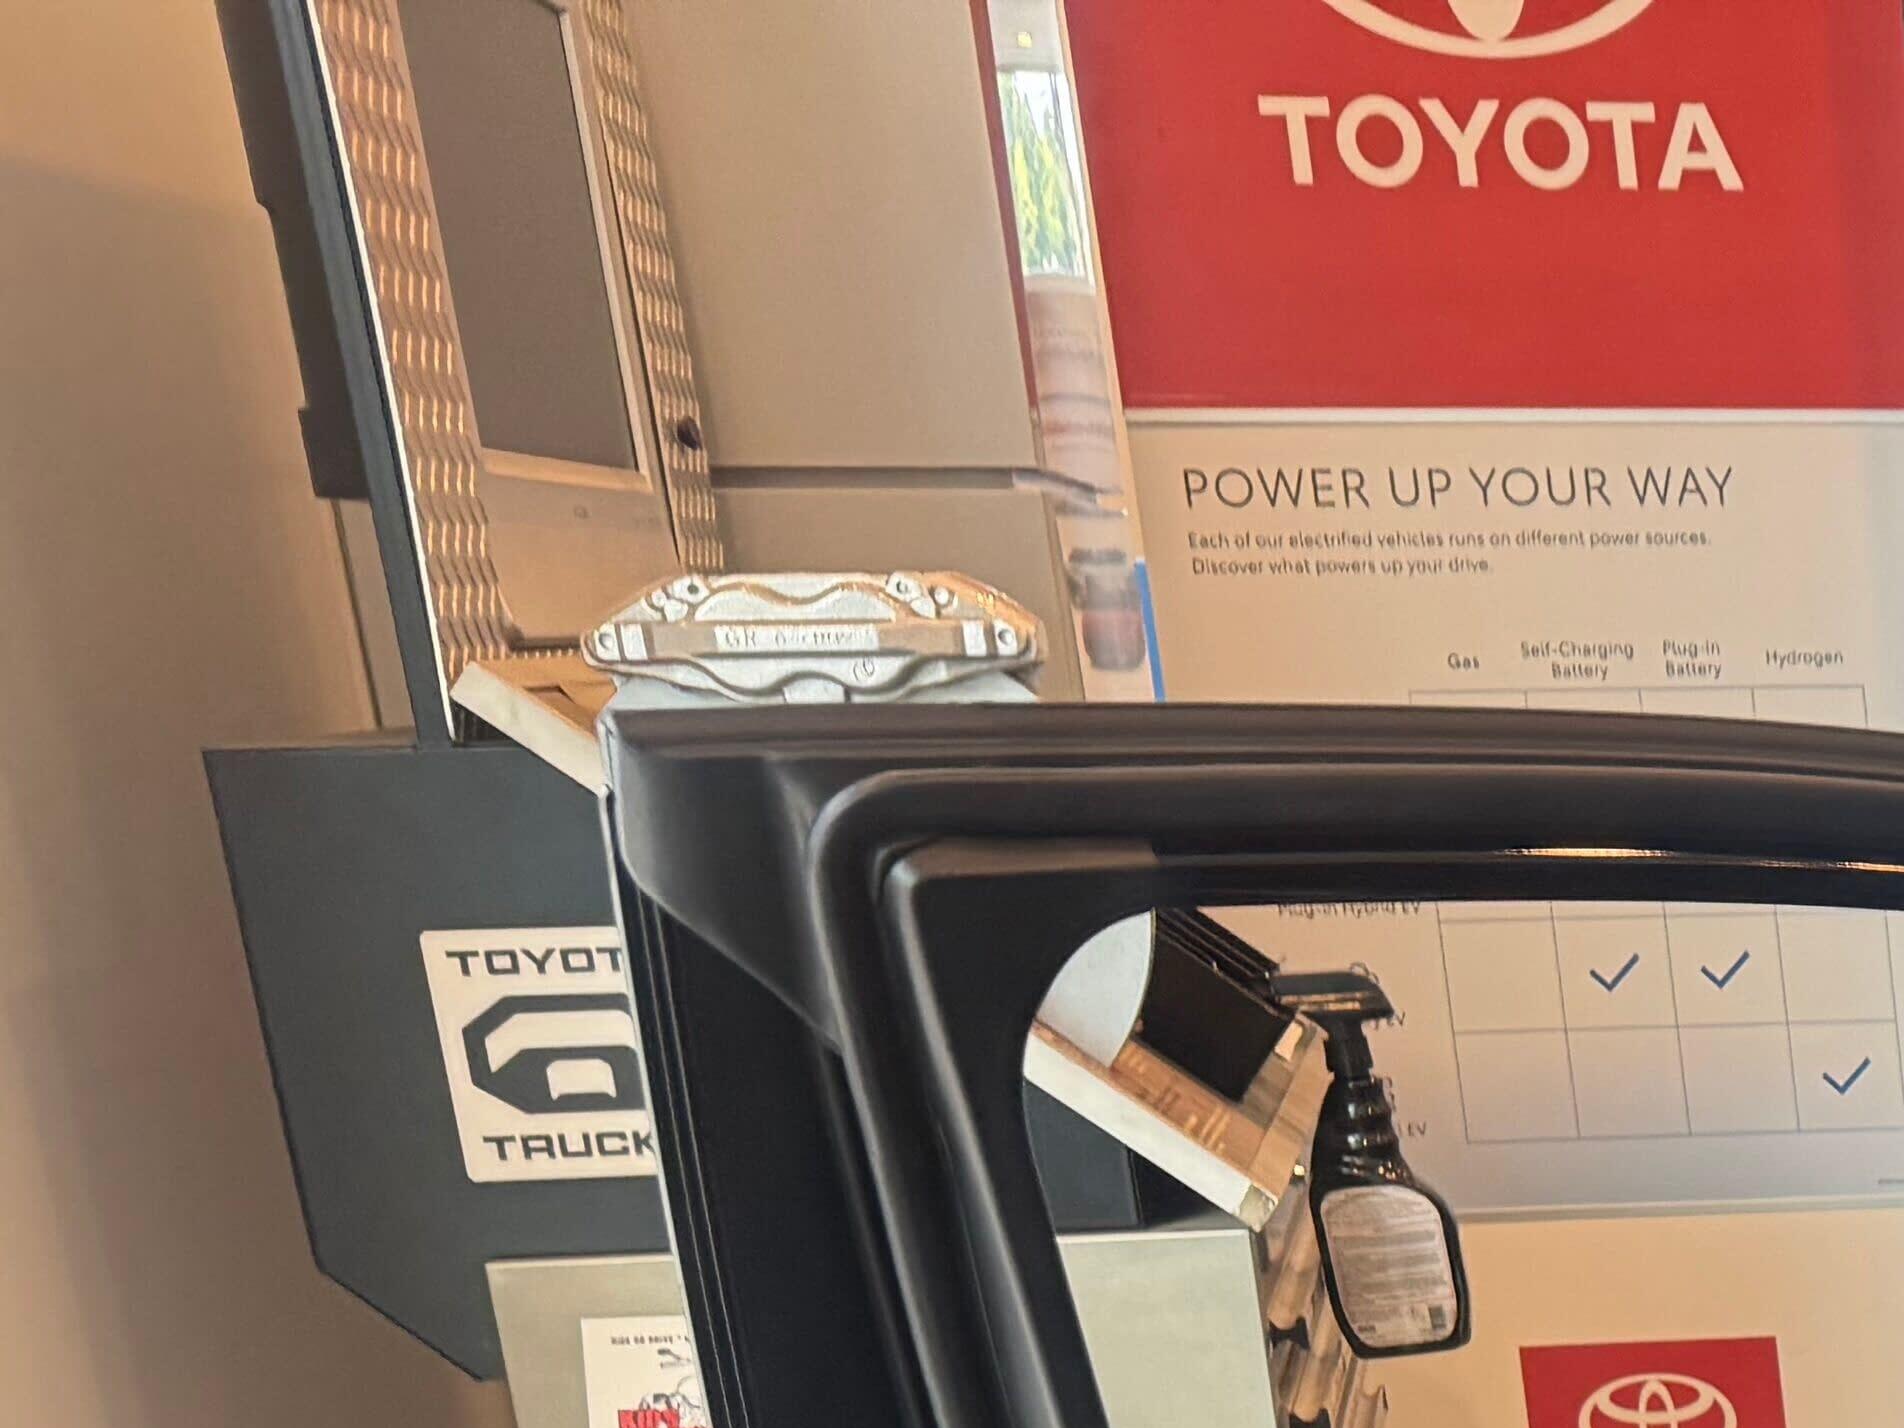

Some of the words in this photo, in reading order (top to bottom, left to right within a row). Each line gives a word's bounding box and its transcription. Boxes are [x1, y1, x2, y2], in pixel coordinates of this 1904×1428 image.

[1257, 92, 1744, 193] TOYOTA
[1183, 466, 1370, 509] POWER
[1388, 466, 1452, 508] UP
[1468, 465, 1612, 508] YOUR
[1626, 465, 1733, 507] WAY
[1187, 531, 1230, 550] Each
[1234, 531, 1251, 549] of
[1255, 535, 1284, 548] our
[1288, 530, 1373, 549] electrified
[1377, 531, 1444, 548] vehicles
[1448, 535, 1485, 548] runs
[1489, 535, 1510, 547] on
[1515, 529, 1586, 548] different
[1589, 533, 1641, 551] power
[1644, 532, 1713, 547] sources.
[1191, 556, 1264, 576] Discover
[1268, 556, 1311, 575] what
[1315, 559, 1377, 577] powers
[1380, 560, 1403, 577] up
[1407, 559, 1444, 577] your
[1520, 640, 1635, 661] Self-Charging
[1661, 639, 1721, 659] Plug-in
[1764, 649, 1844, 669] Hydrogen
[1447, 652, 1480, 671] Gas
[1551, 661, 1610, 682] Battery
[1665, 659, 1722, 681] Battery
[444, 947, 623, 977] TOYOT
[482, 1129, 654, 1161] TRUCK
